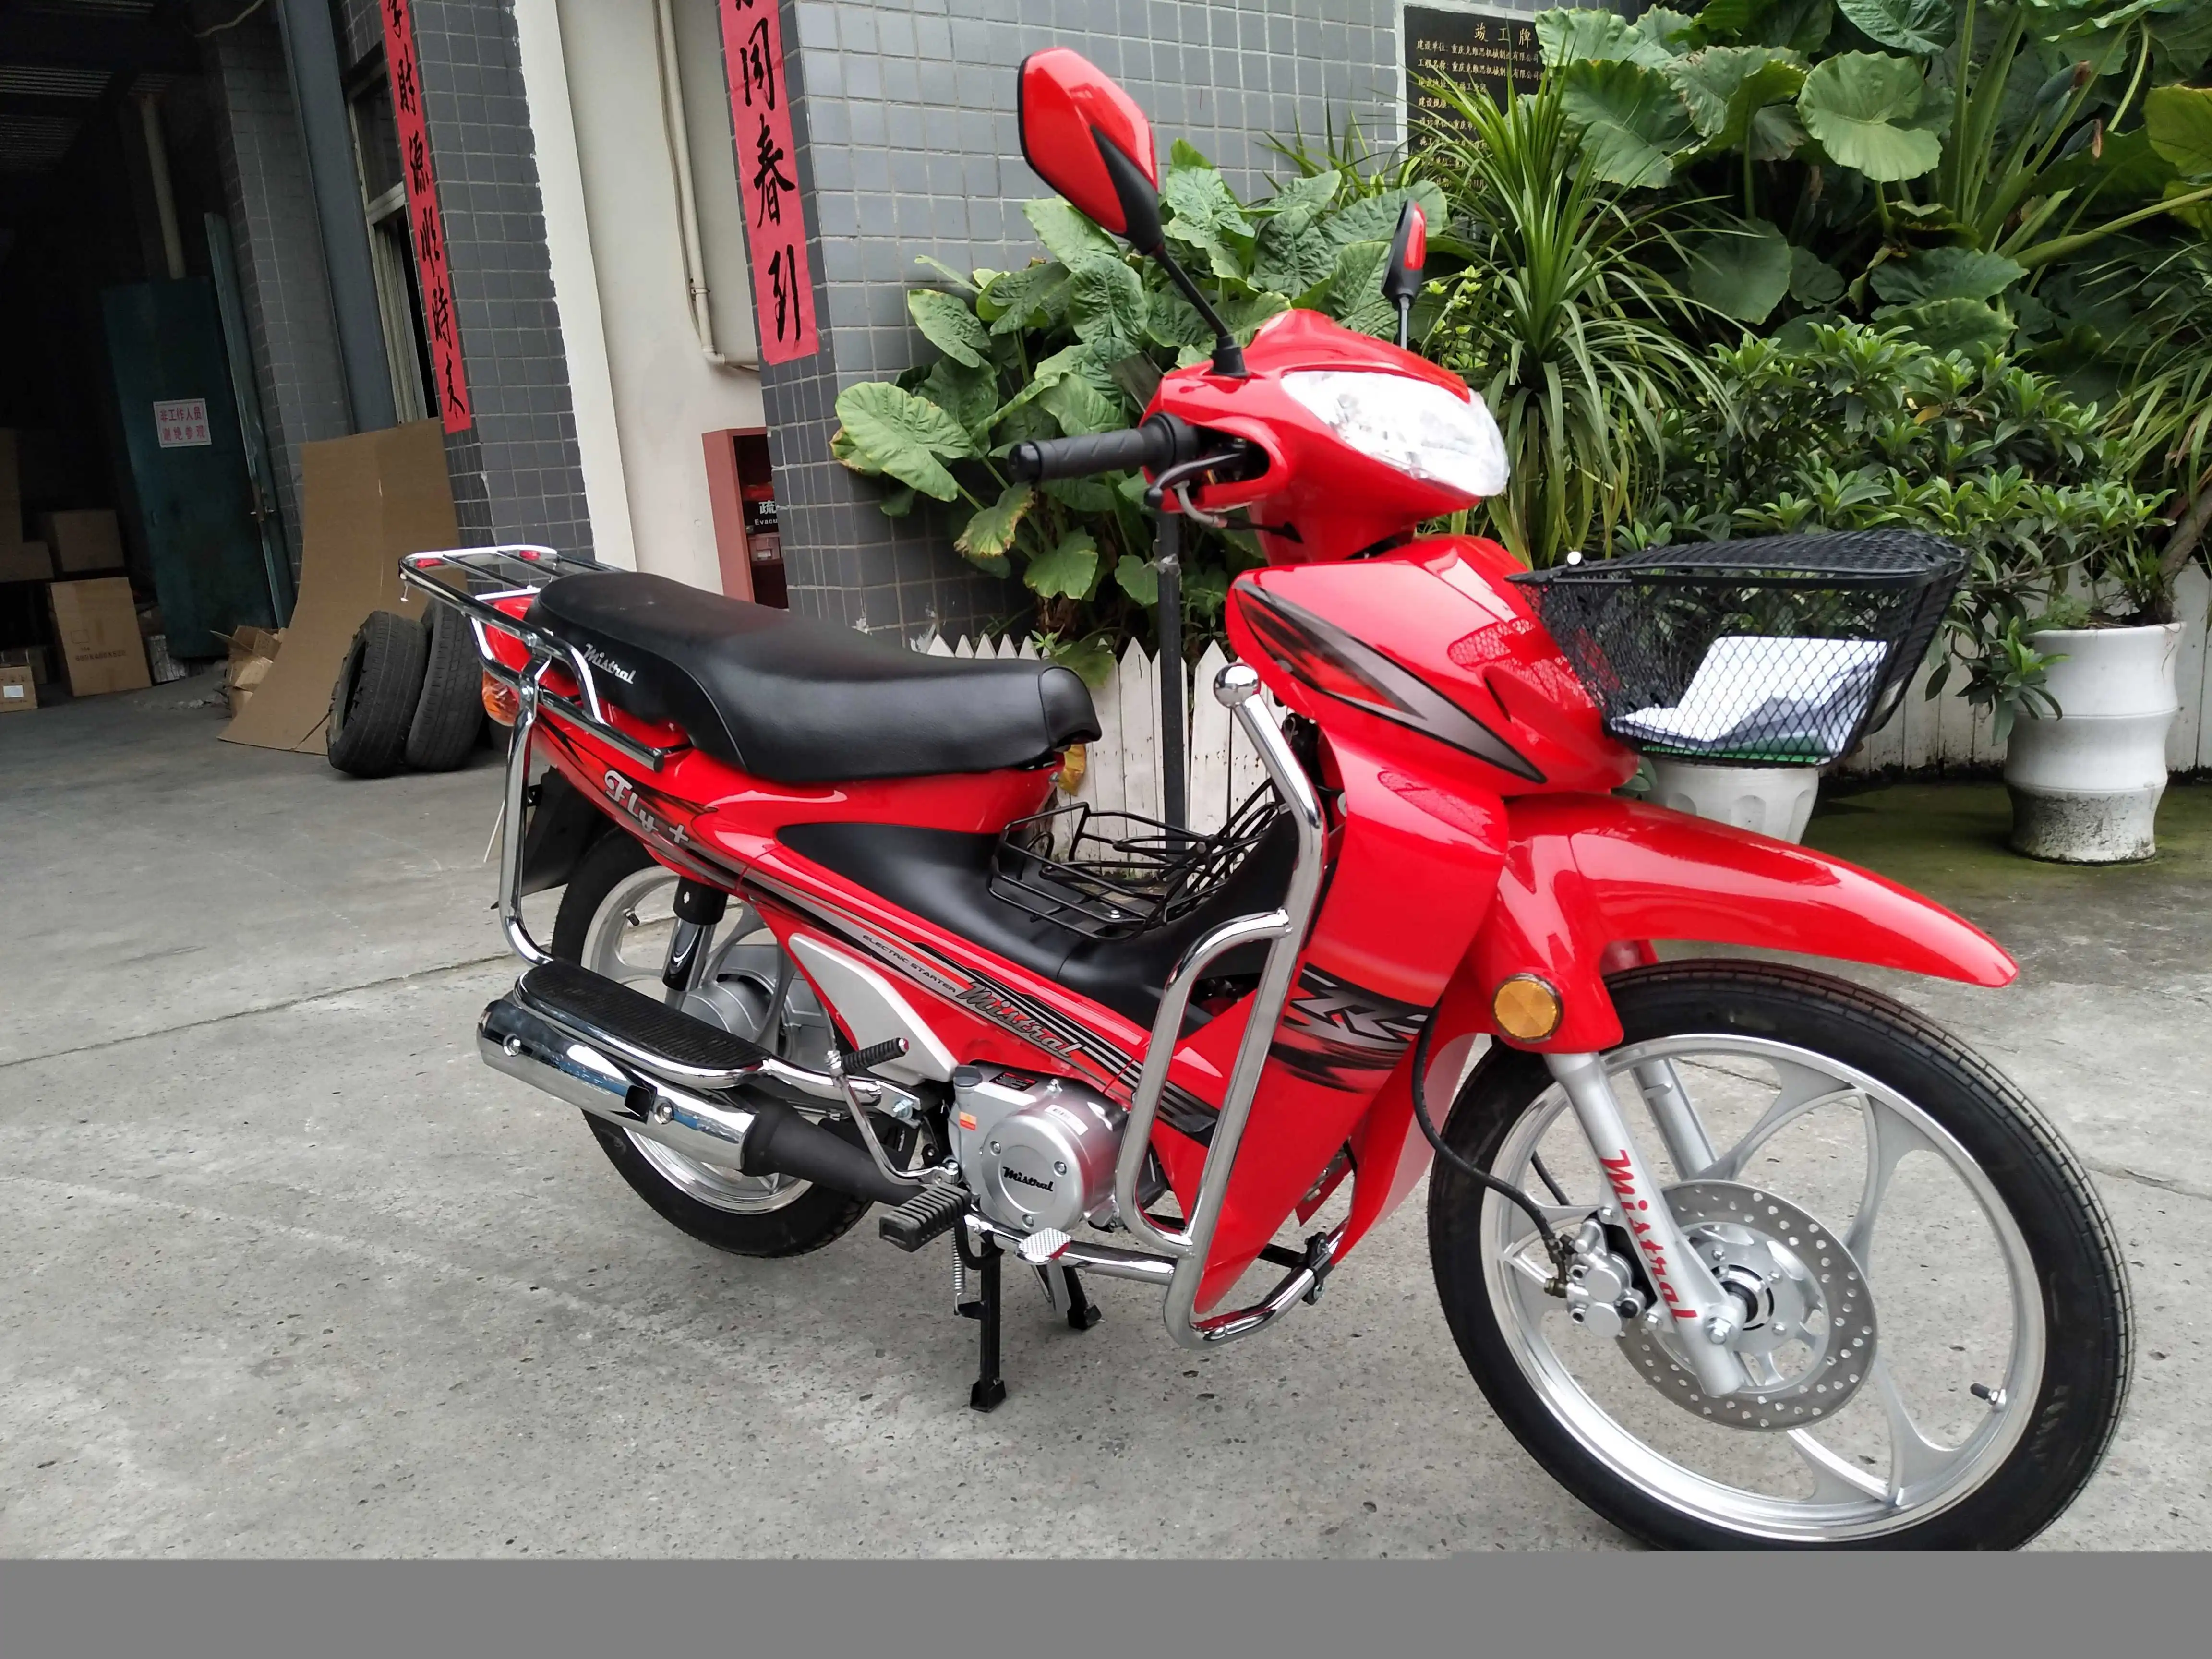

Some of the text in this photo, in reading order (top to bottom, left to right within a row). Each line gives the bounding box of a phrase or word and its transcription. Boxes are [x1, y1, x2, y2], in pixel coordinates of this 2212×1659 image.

[1474, 22, 1532, 48] 竣工牌
[159, 406, 202, 422] 非工作人员
[584, 643, 636, 685] Mistral
[863, 935, 956, 993] ELECTRIC STARTER
[955, 981, 1083, 1058] Mistral
[1002, 1166, 1054, 1192] Mistral
[1600, 1149, 1698, 1322] Mistral
